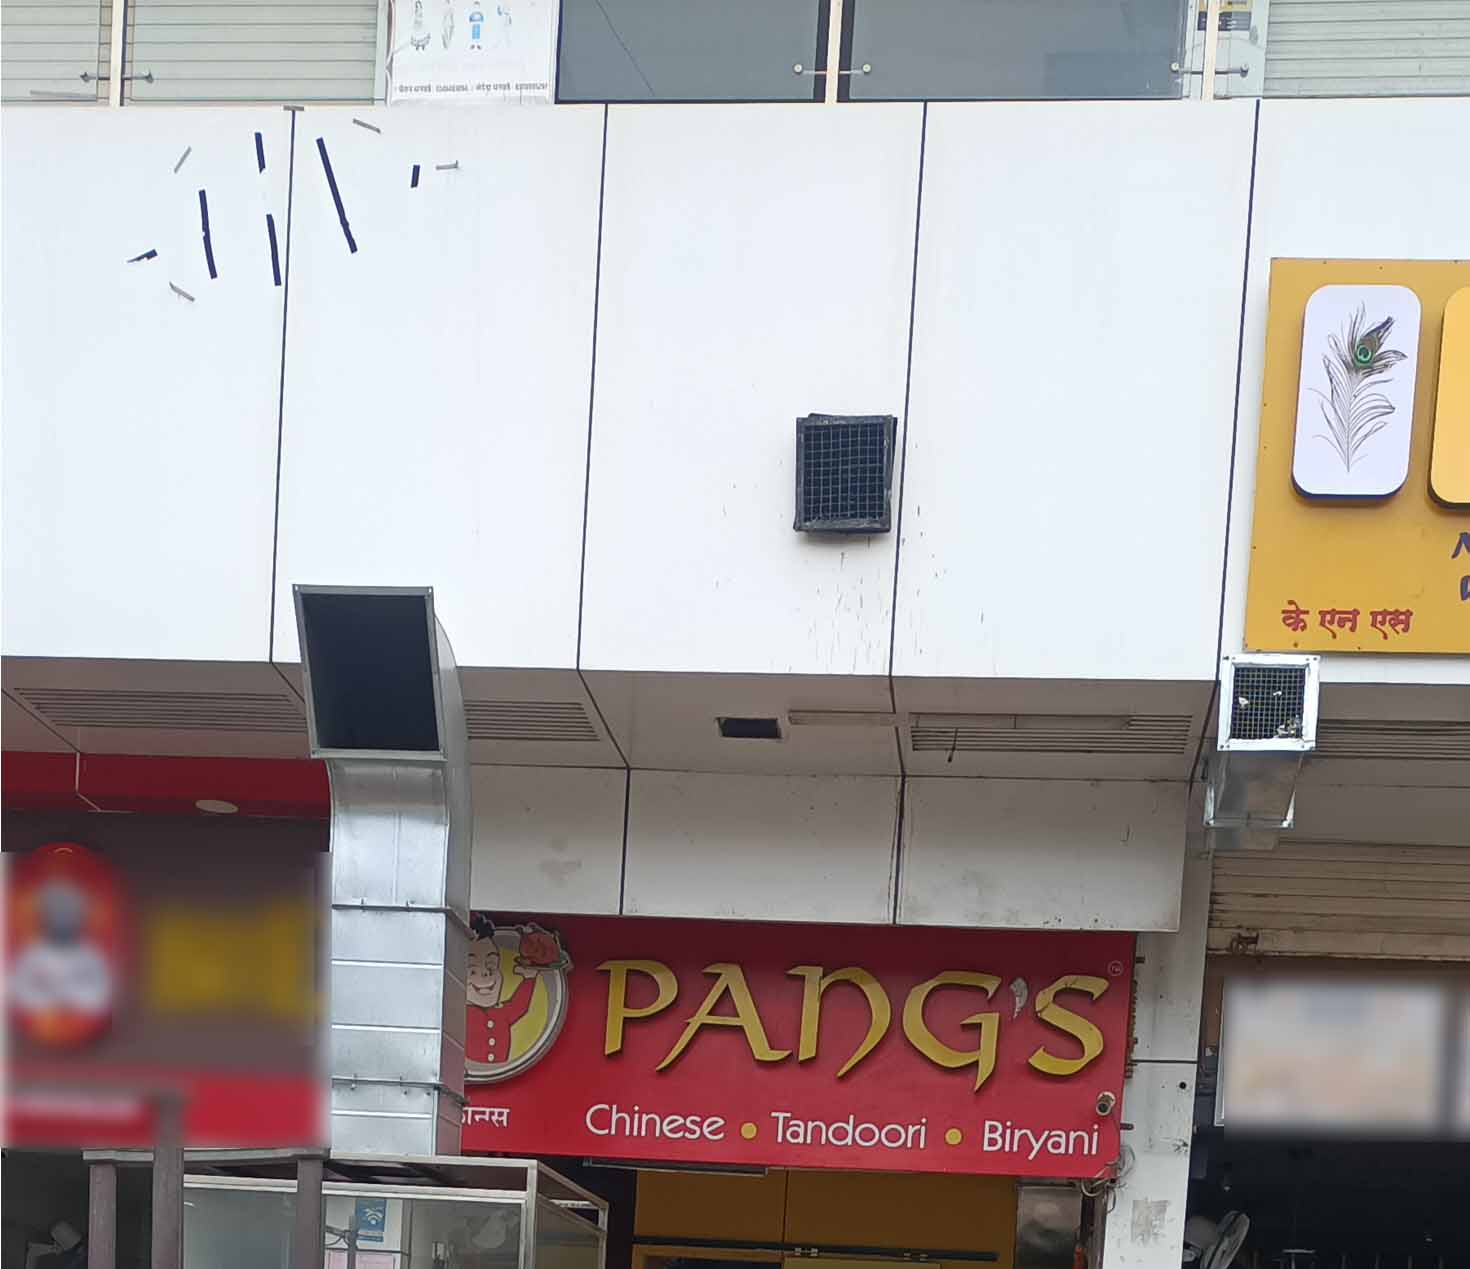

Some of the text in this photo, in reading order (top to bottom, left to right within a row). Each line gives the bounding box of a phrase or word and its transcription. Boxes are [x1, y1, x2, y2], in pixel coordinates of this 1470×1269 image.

[1281, 599, 1414, 641] के एन एस
[596, 959, 1110, 1093] PANG'S
[584, 1103, 1099, 1161] Chinese Tandoori Biryani
